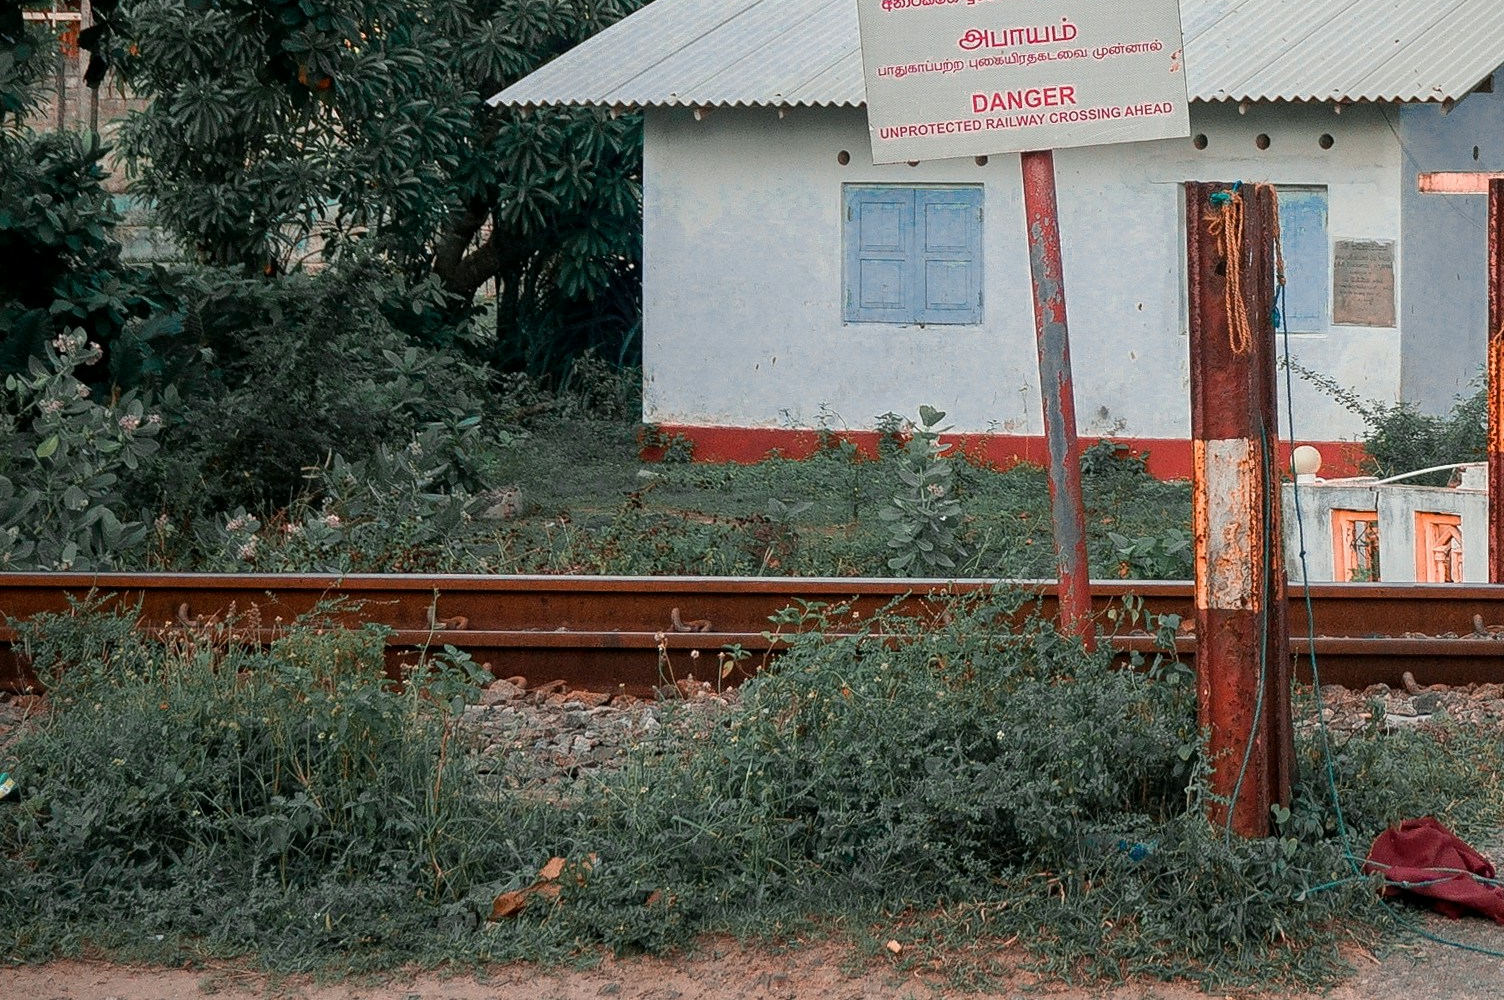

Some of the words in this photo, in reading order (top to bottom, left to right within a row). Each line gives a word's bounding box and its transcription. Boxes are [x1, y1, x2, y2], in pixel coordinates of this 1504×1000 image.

[959, 17, 1077, 50] அபாயம்
[878, 58, 964, 78] பாதுகாப்பற்ற
[1092, 39, 1163, 60] முன்னால்
[972, 86, 1077, 113] DANGER
[880, 118, 982, 139] UNPROTECTED
[986, 113, 1046, 130] RAILWAY
[1049, 106, 1121, 124] CROSSING
[1124, 101, 1173, 117] AHEAD
